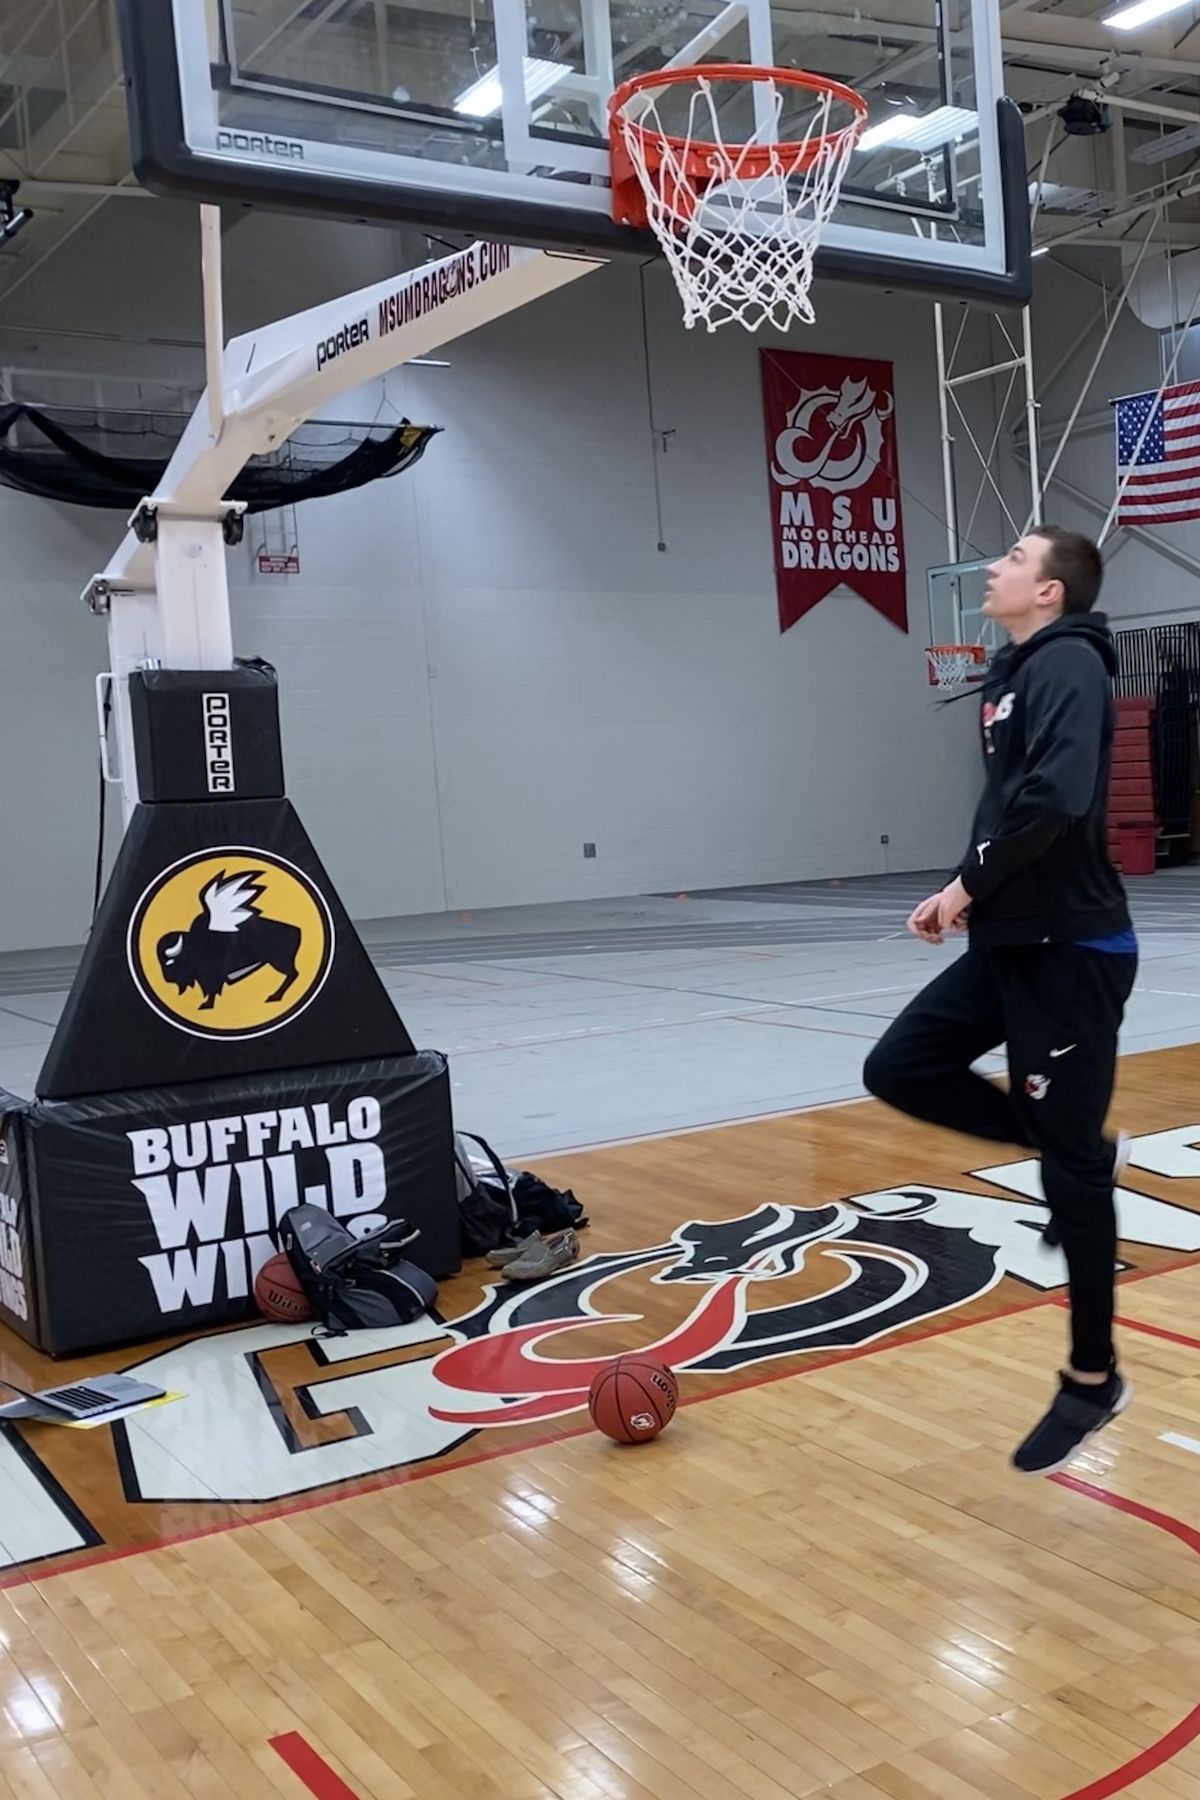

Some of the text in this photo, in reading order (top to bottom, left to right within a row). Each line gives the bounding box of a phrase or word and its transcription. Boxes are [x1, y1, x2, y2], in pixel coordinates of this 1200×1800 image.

[782, 527, 896, 544] MOORHEAD
[781, 541, 900, 572] DRAGONS
[126, 1096, 381, 1175] BUFFALO
[130, 1142, 388, 1250] WILD
[267, 1288, 308, 1313] Wils
